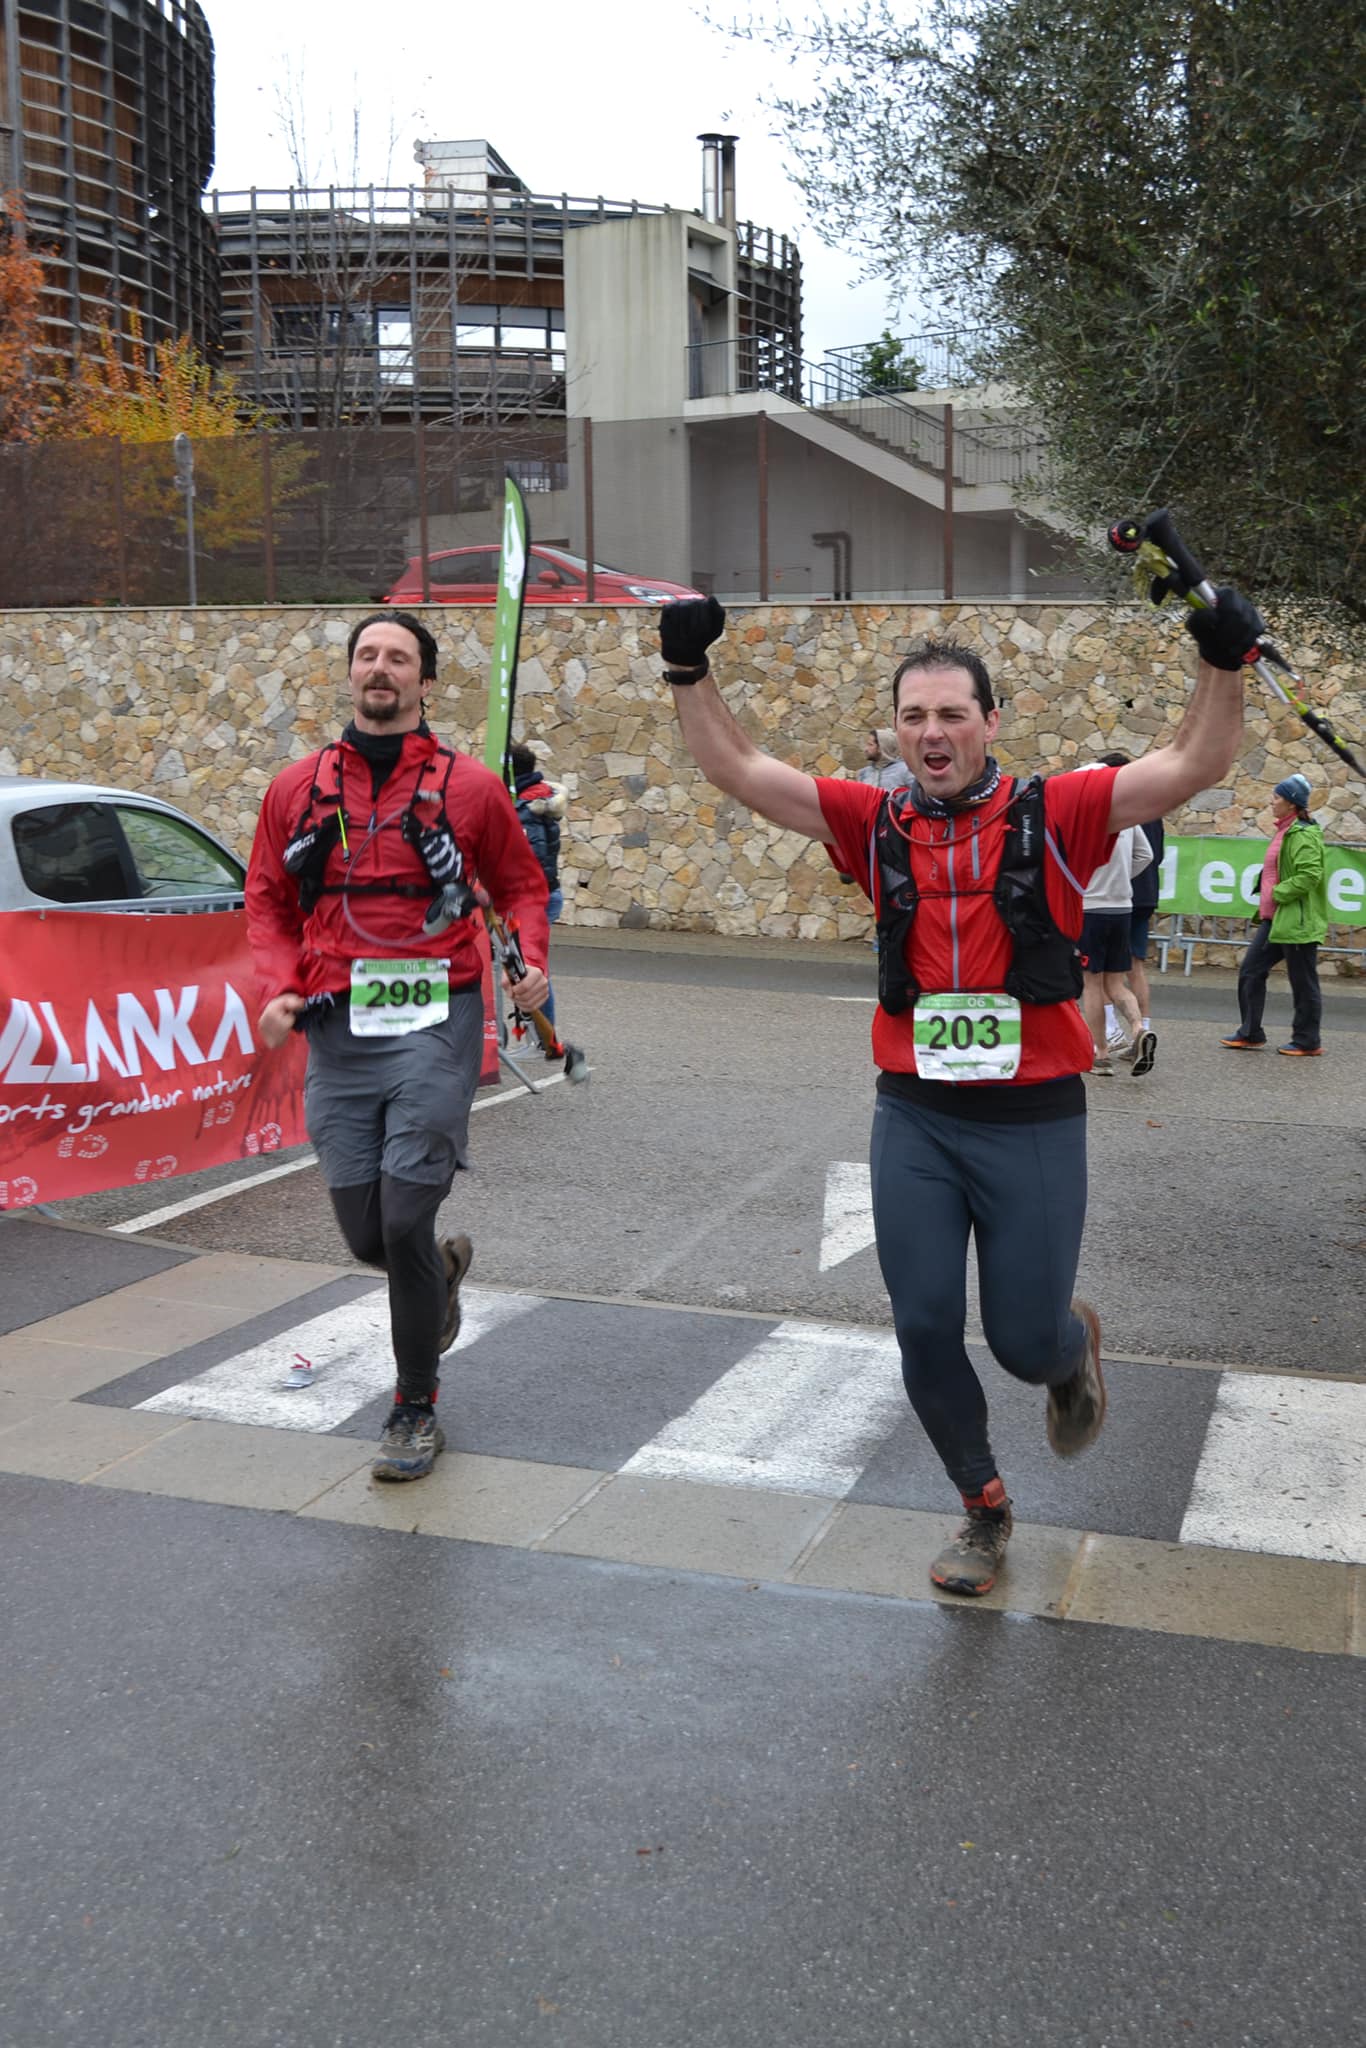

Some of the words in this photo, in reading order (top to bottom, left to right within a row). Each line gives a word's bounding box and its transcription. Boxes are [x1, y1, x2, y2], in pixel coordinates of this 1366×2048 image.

[366, 979, 432, 1007] 298
[928, 1014, 1001, 1050] 203
[67, 1082, 183, 1134] grandeur
[191, 1069, 252, 1101] nature
